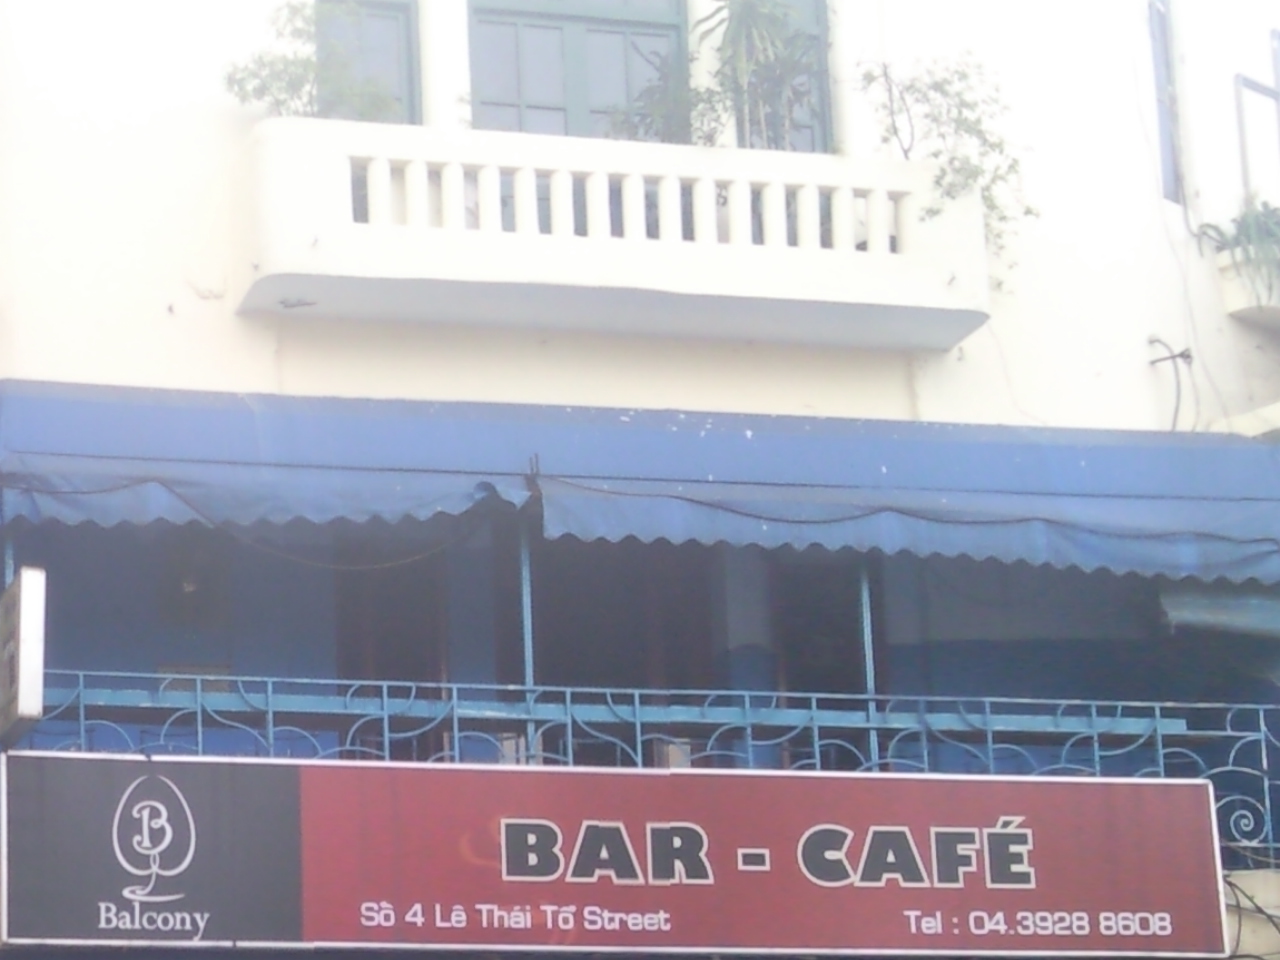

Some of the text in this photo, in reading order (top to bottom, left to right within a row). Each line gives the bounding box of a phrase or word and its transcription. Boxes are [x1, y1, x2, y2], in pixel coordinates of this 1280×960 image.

[500, 819, 714, 885] BAR
[797, 816, 1036, 889] CAFÉ
[98, 901, 210, 941] Balcony
[404, 903, 425, 927] 4
[434, 903, 467, 928] Lê
[475, 904, 532, 928] Thái
[583, 906, 671, 931] Street
[903, 910, 942, 934] Tel
[968, 911, 1090, 935] 04.3928
[1099, 912, 1172, 936] 8608
